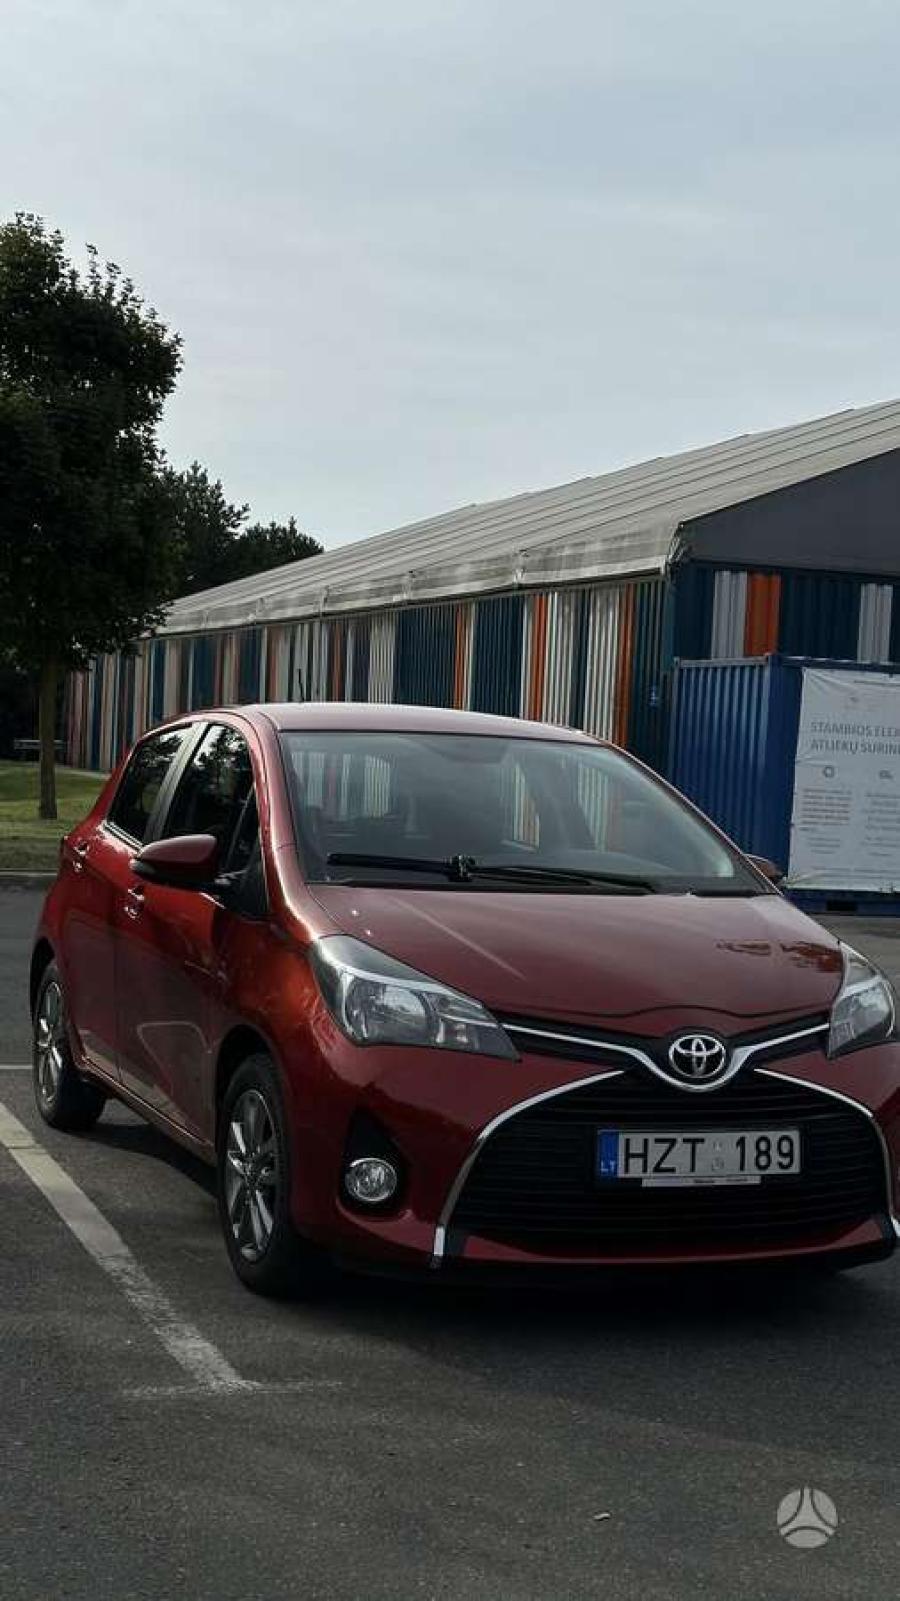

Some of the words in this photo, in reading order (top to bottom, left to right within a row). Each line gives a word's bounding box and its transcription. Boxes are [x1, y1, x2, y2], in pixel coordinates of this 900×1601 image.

[600, 1160, 616, 1173] LT
[624, 1137, 705, 1174] HZT
[735, 1135, 794, 1172] 189
